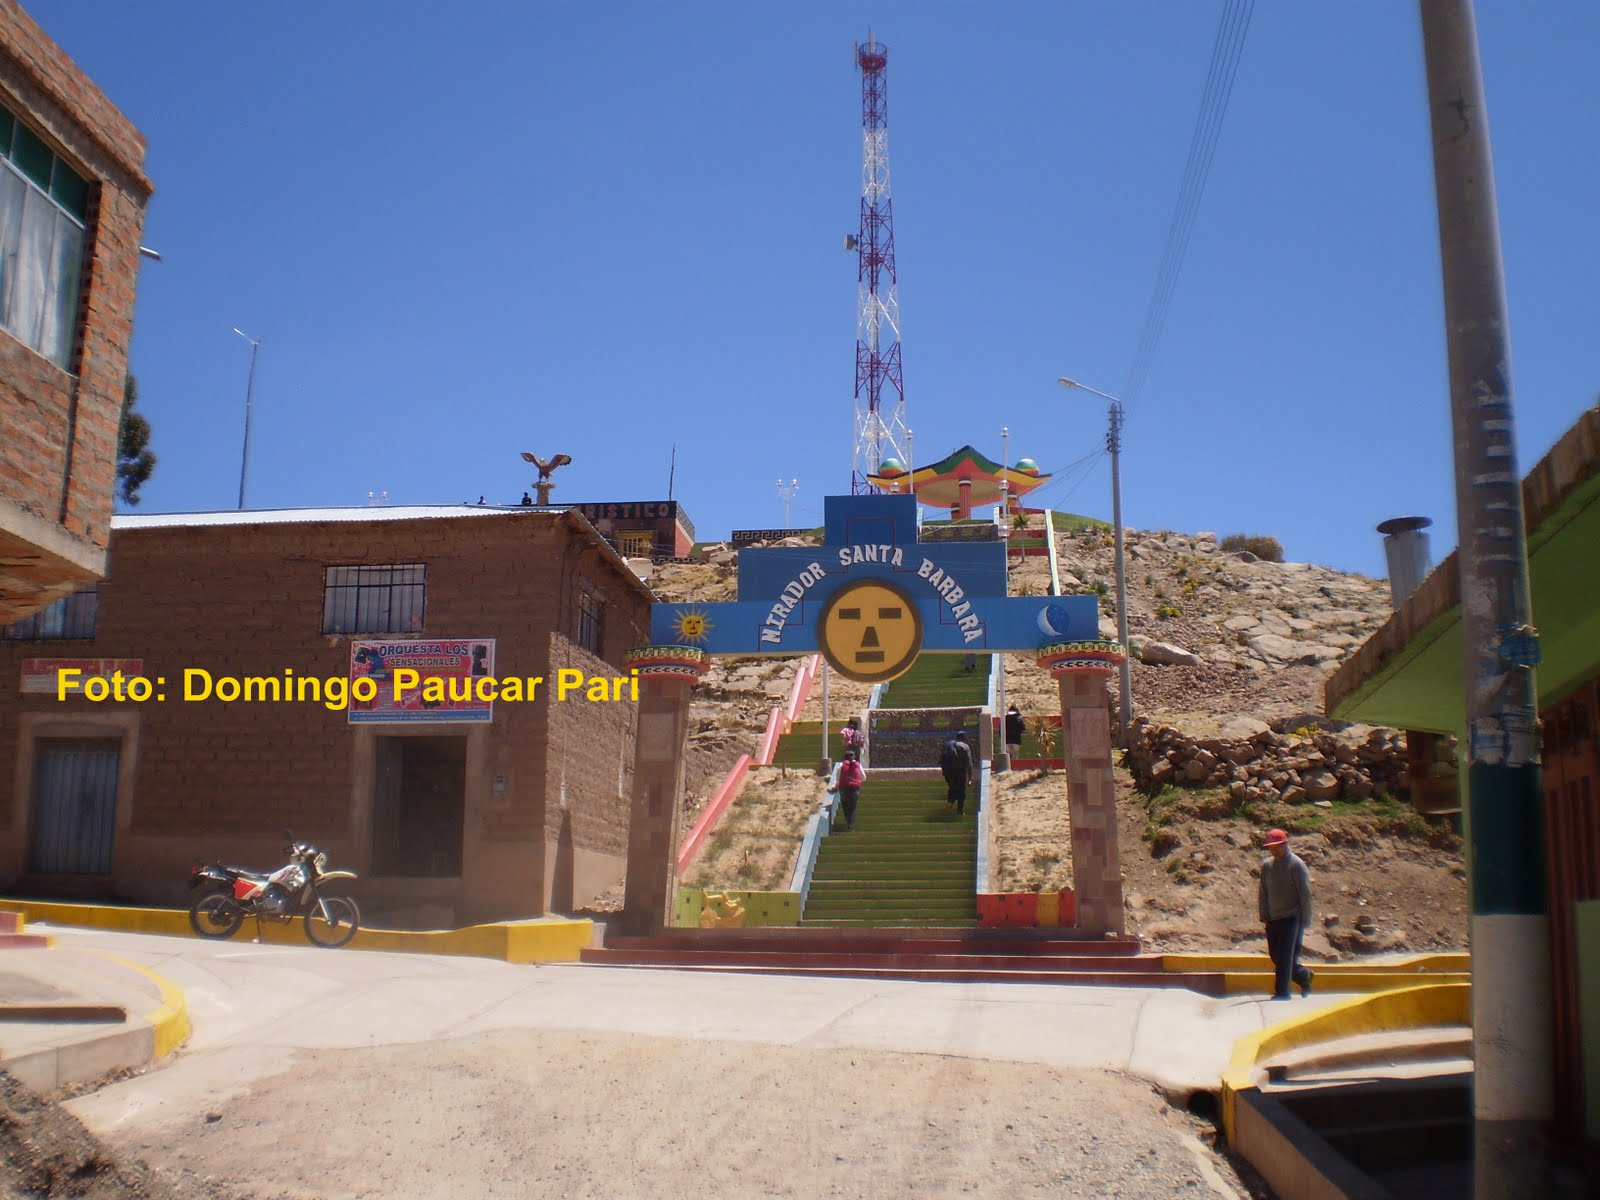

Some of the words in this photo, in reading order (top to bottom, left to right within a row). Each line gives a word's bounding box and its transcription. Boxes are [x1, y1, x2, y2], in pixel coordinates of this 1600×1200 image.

[577, 503, 670, 520] RISTICO
[760, 561, 827, 645] MIRADOR
[838, 543, 905, 568] SANTA
[916, 557, 985, 645] BARBARA
[378, 644, 441, 657] ORQUESTA
[445, 644, 469, 656] LOS
[389, 656, 461, 668] SENSACIONALES
